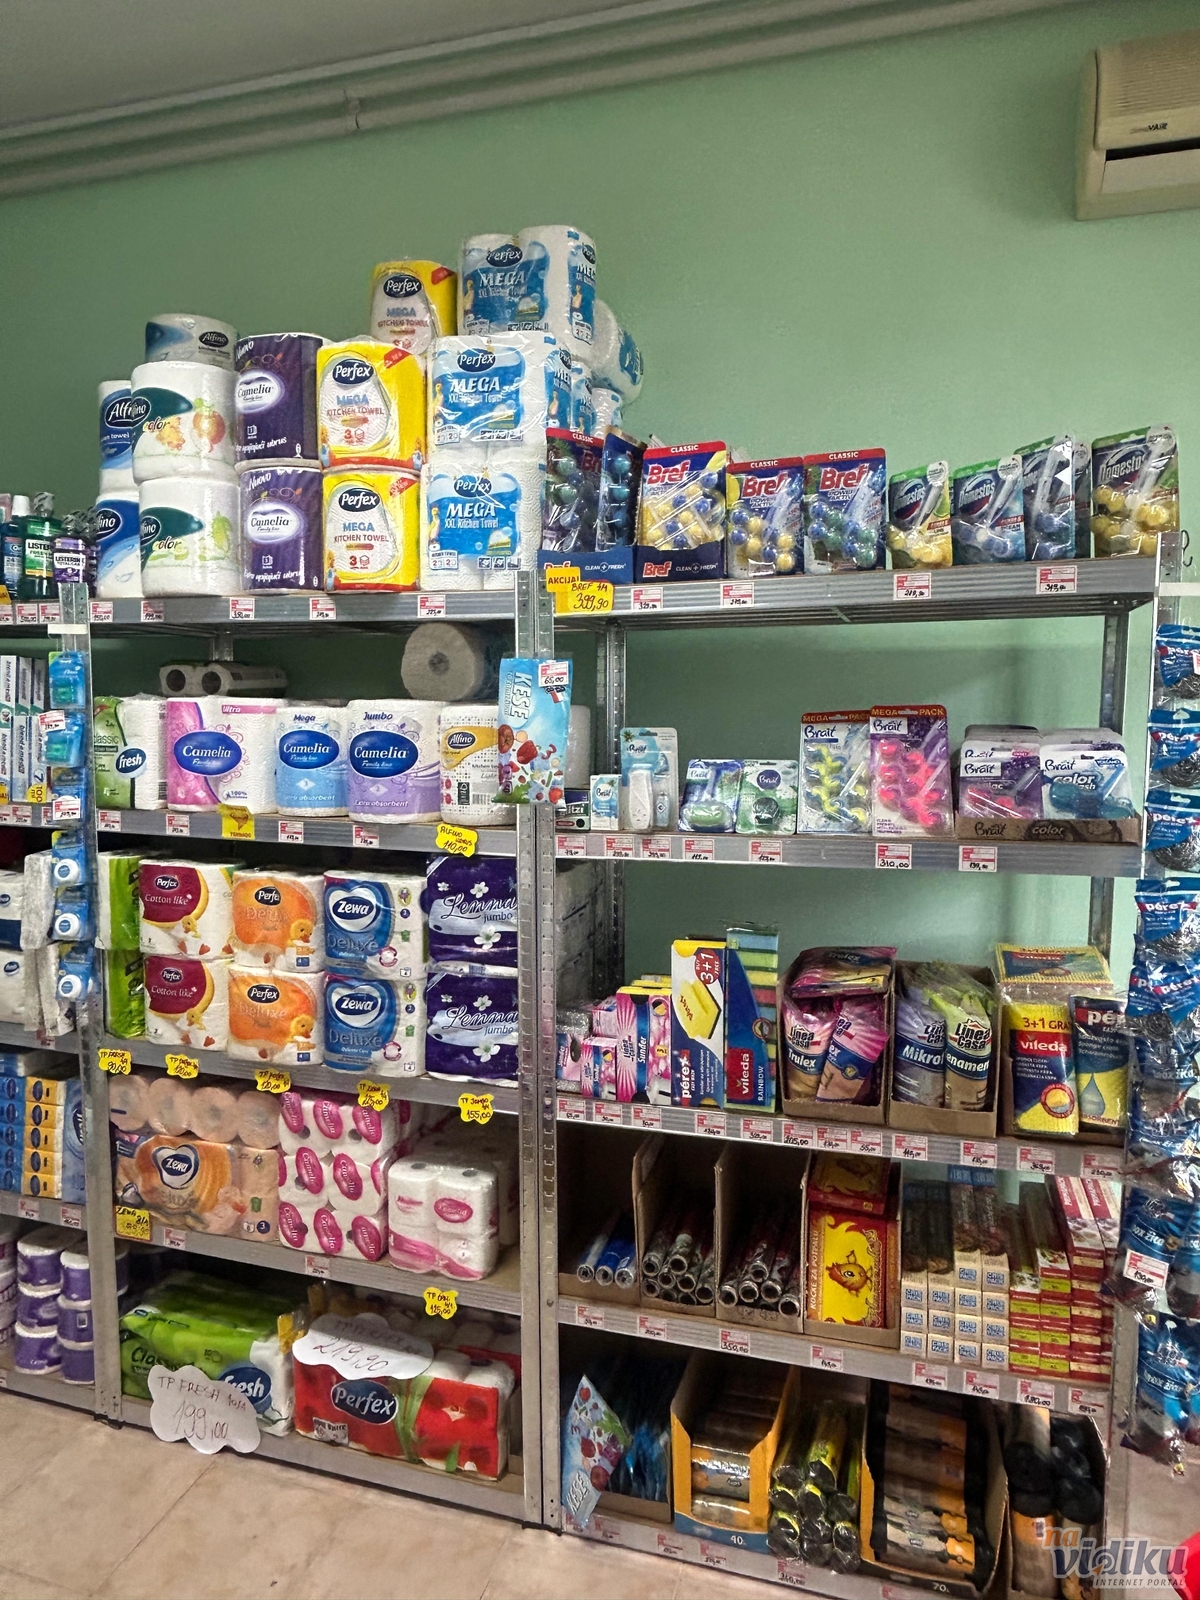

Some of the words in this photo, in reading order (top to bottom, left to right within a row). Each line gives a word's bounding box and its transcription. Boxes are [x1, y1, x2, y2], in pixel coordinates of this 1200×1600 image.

[488, 248, 521, 263] Perfex
[386, 278, 420, 295] Perfex
[480, 271, 526, 287] MEGA
[387, 307, 416, 317] MEGA
[459, 352, 496, 368] Perfex
[335, 363, 372, 381] Perfex
[237, 384, 272, 398] Camelia
[450, 377, 500, 393] MEGA
[336, 394, 369, 406] MEGA
[108, 401, 132, 422] Alfi
[572, 432, 594, 444] CLASSIC
[670, 445, 699, 453] CLASSIC
[828, 451, 859, 460] CLASSIC
[750, 460, 779, 468] CLASSIC
[646, 460, 691, 485] Bref
[820, 464, 868, 491] Bref
[248, 472, 272, 491] Nuovo
[456, 479, 491, 494] Perfex
[741, 472, 790, 499] Bref
[340, 490, 378, 509] Perfex
[959, 482, 996, 507] Domestos
[447, 503, 496, 518] MEGA
[251, 516, 289, 528] Camelia
[343, 521, 375, 532] MEGA
[334, 533, 361, 543] KITCHEN
[361, 533, 389, 543] TOWEL
[643, 561, 672, 578] Bref
[571, 583, 593, 592] BREF
[573, 592, 609, 611] 399,90
[544, 675, 565, 685] 65,00
[509, 671, 533, 720] KESE
[293, 714, 316, 723] Mega
[363, 711, 393, 722] Jumbo
[871, 708, 898, 716] MEGA
[919, 708, 945, 716] PACK
[804, 724, 837, 739] Brait
[873, 719, 903, 732] Brait
[448, 732, 473, 745] Alfino
[182, 745, 232, 759] Camelia
[283, 742, 330, 755] Camelia
[354, 745, 408, 760] Camelia
[118, 753, 142, 770] fresh
[964, 763, 996, 775] Brait
[1044, 759, 1077, 772] Brait
[1053, 773, 1095, 785] color
[974, 821, 1007, 837] Brait
[1032, 824, 1064, 836] color
[879, 858, 911, 870] 310,00
[156, 877, 178, 890] Perfex
[144, 893, 172, 905] Cotton
[172, 894, 190, 906] like
[337, 900, 370, 915] Zewa
[483, 911, 513, 923] jumbo
[327, 932, 379, 952] Deluxe
[701, 952, 714, 983] 3+1
[161, 969, 181, 982] Perfex
[151, 986, 177, 998] Cotton
[178, 986, 193, 999] like
[250, 985, 278, 1001] Perfex
[340, 996, 375, 1011] Zewa
[1022, 1017, 1046, 1028] 3+1
[329, 1028, 383, 1048] Deluxe
[484, 1025, 514, 1036] jumbo
[790, 1027, 815, 1041] Linea
[954, 1022, 992, 1041] Linea
[957, 1037, 987, 1051] Casa
[1020, 1038, 1068, 1053] vileda
[788, 1048, 816, 1069] Trulex
[680, 1056, 692, 1099] pérex
[741, 1053, 750, 1095] vileda
[165, 1158, 189, 1173] Zewa
[260, 1222, 266, 1230] 3
[810, 1269, 818, 1281] ZA
[313, 1337, 389, 1372] 219,90
[158, 1375, 175, 1390] TP
[179, 1380, 220, 1401] FRESH
[334, 1386, 395, 1416] Perfex
[172, 1400, 230, 1442] 199,00
[567, 1473, 590, 1514] KESE
[730, 1535, 744, 1545] 40
[933, 1582, 948, 1593] 70
